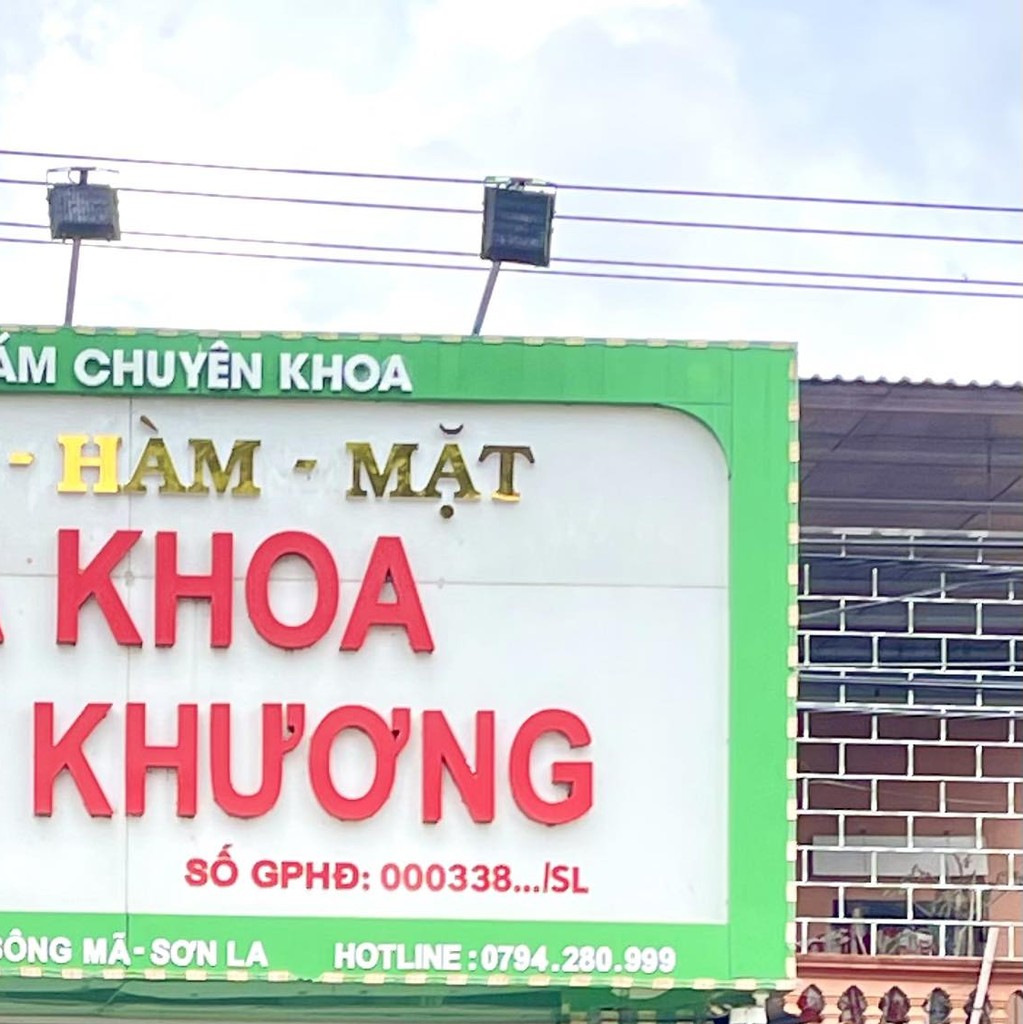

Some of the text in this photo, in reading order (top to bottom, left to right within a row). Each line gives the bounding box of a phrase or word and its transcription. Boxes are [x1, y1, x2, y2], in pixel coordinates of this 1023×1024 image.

[75, 340, 262, 389] CHUYÊN
[280, 352, 413, 392] KHOA
[57, 416, 261, 497] HÀM
[346, 424, 535, 519] MẶT
[56, 528, 435, 654] KHOA
[33, 701, 595, 827] KHƯƠNG
[184, 844, 239, 887] SỐ
[251, 858, 370, 891] GPHĐ:
[227, 940, 269, 968] LA
[480, 944, 677, 974] 0794.280.999
